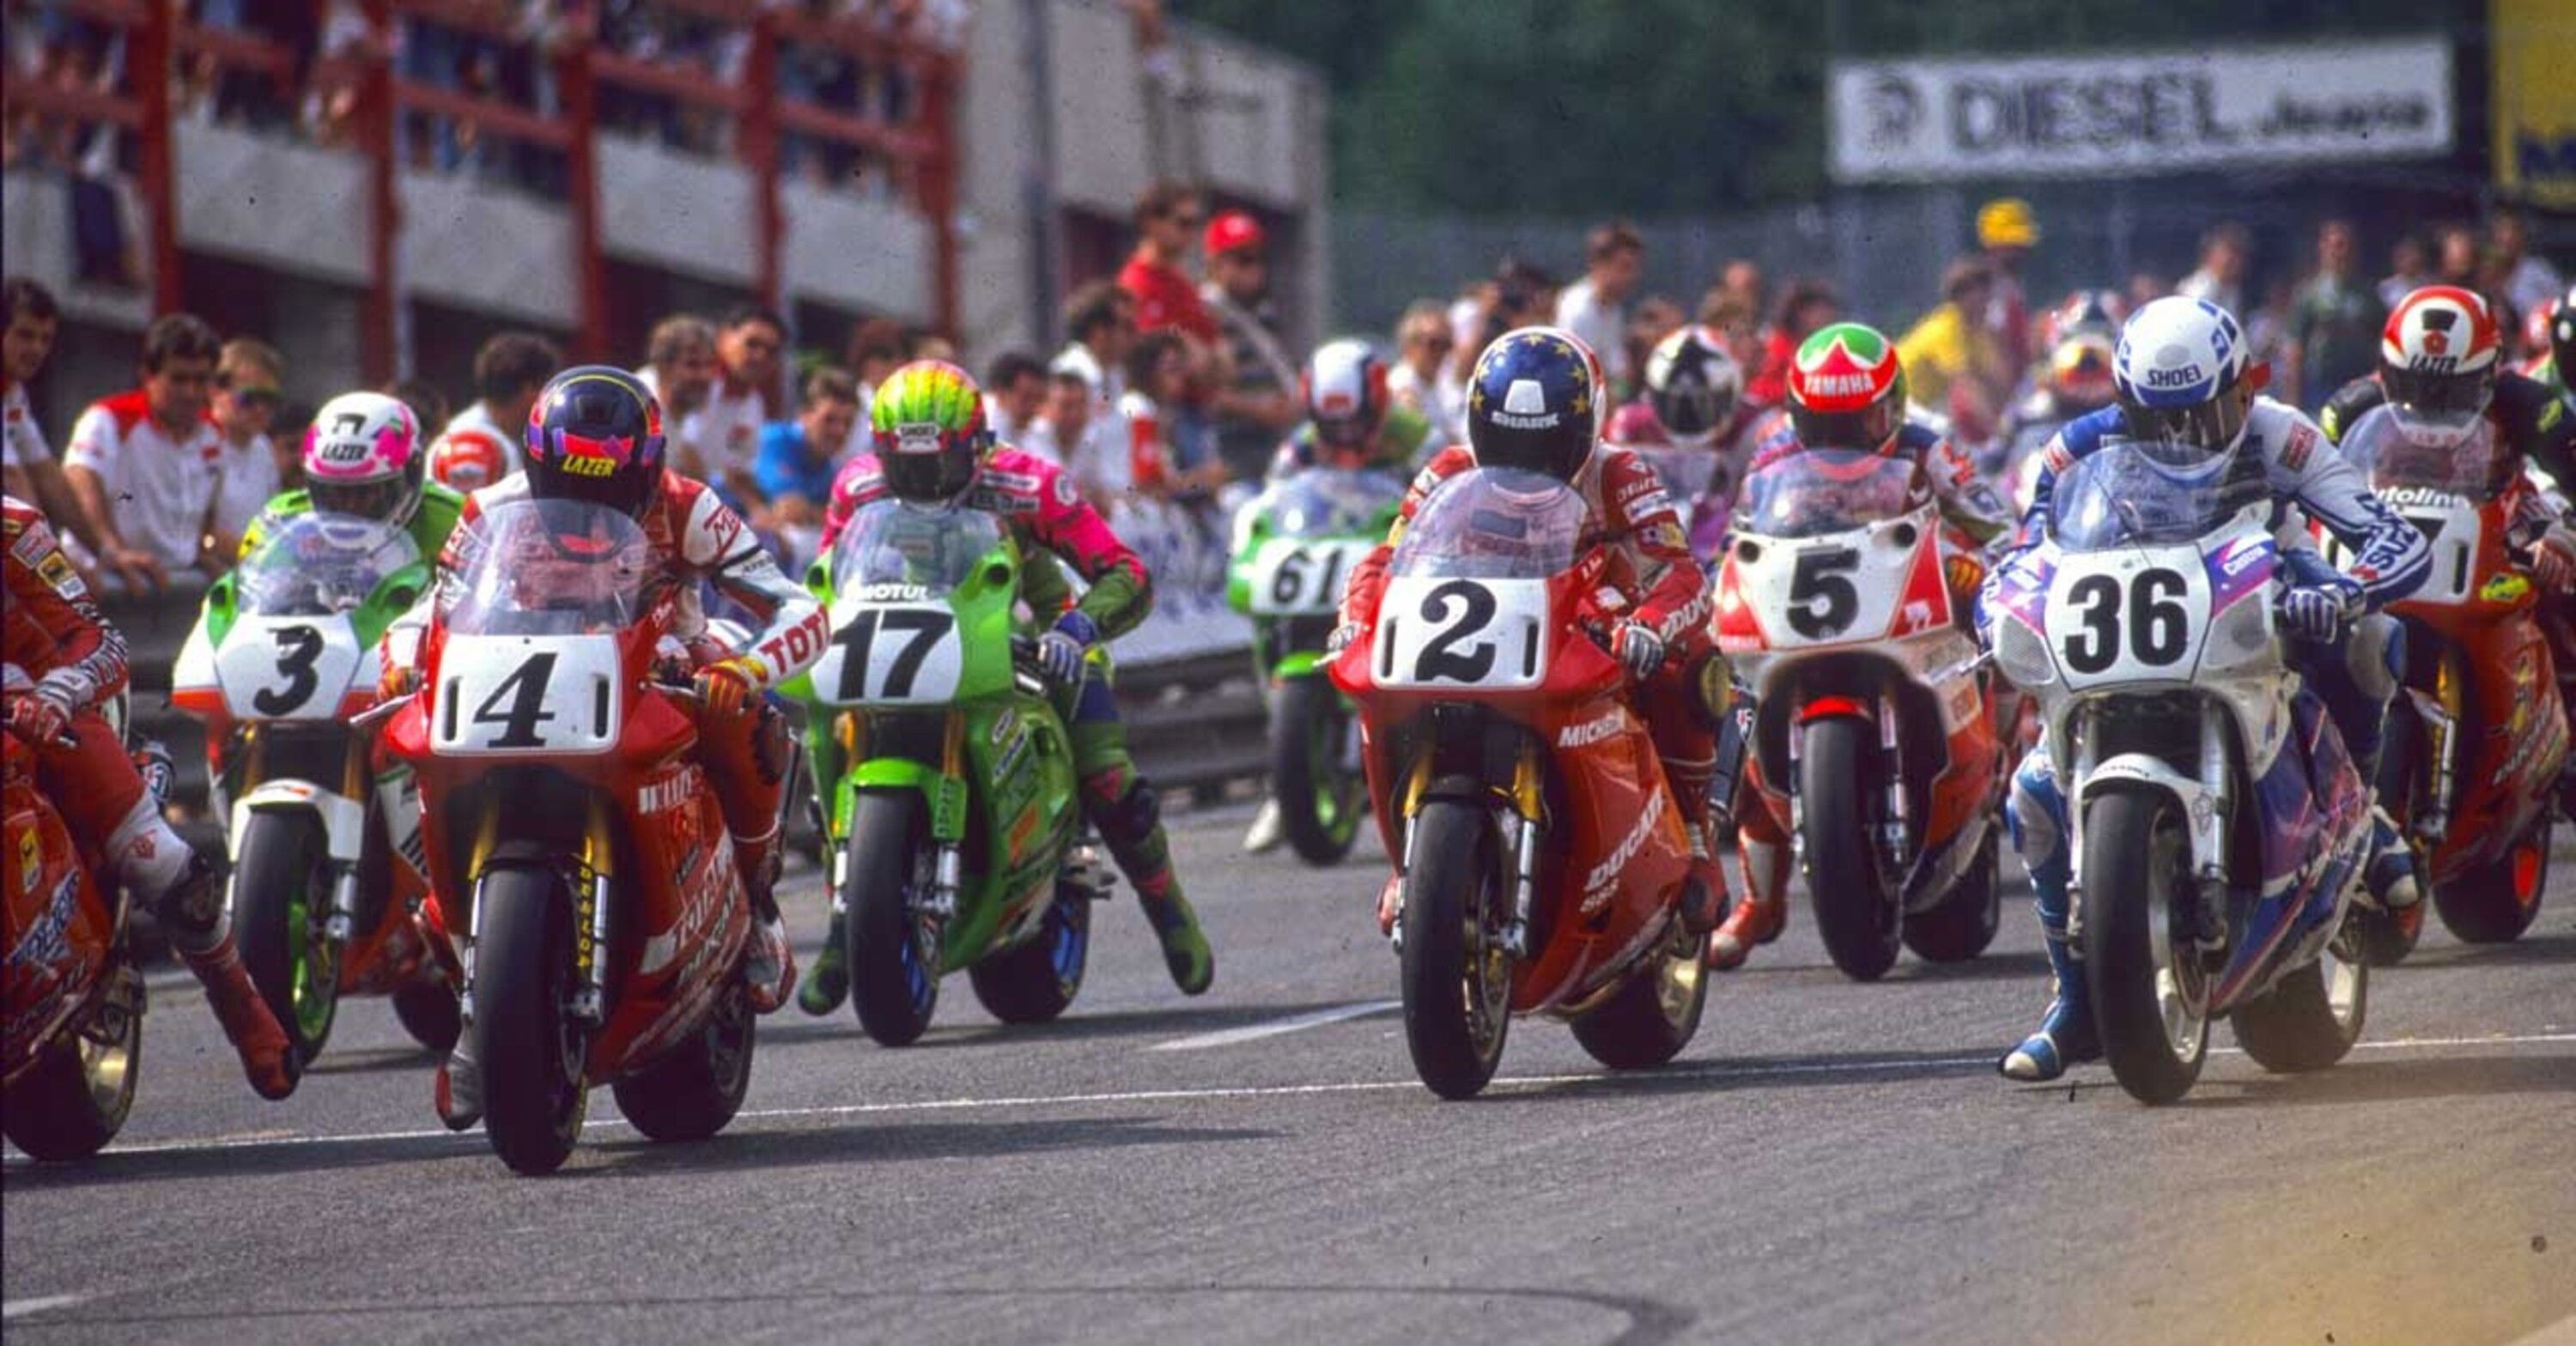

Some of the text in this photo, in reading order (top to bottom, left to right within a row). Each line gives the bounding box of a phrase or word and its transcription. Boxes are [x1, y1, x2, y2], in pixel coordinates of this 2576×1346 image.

[1949, 76, 2233, 150] DIESEL
[1804, 373, 1876, 396] YAMAHA
[2148, 363, 2202, 387] SHOEI
[321, 442, 368, 461] LAZER
[1491, 410, 1559, 429] SHARK
[562, 454, 617, 478] LAZER
[1273, 547, 1343, 606] 61
[1787, 548, 1862, 640] 5
[831, 609, 956, 701] 17
[1415, 579, 1497, 683] 2
[2064, 567, 2189, 673] 36
[253, 625, 324, 716] 3
[472, 652, 560, 749] 4
